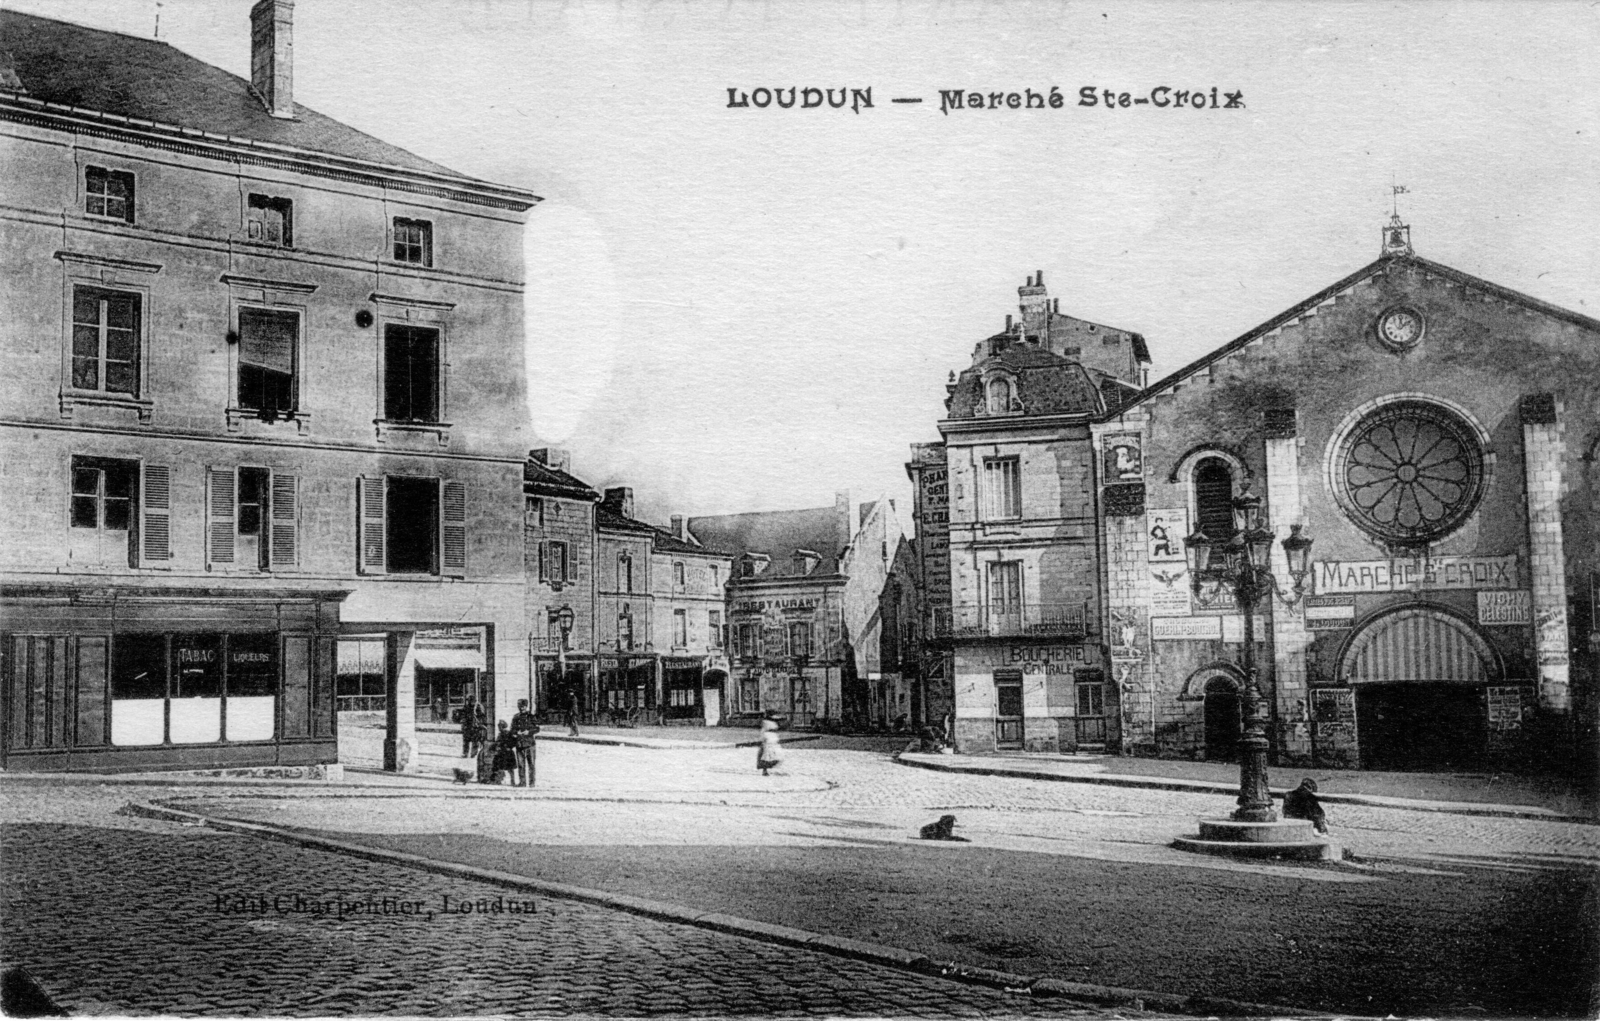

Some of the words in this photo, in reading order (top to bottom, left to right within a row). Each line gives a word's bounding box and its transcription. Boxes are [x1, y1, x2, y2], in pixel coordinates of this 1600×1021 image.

[1445, 561, 1512, 587] CROIX
[1483, 592, 1526, 606] VICHY
[180, 648, 215, 662] TABAC
[1012, 646, 1084, 662] BOUCHERIE
[1023, 662, 1074, 676] CENTRALE
